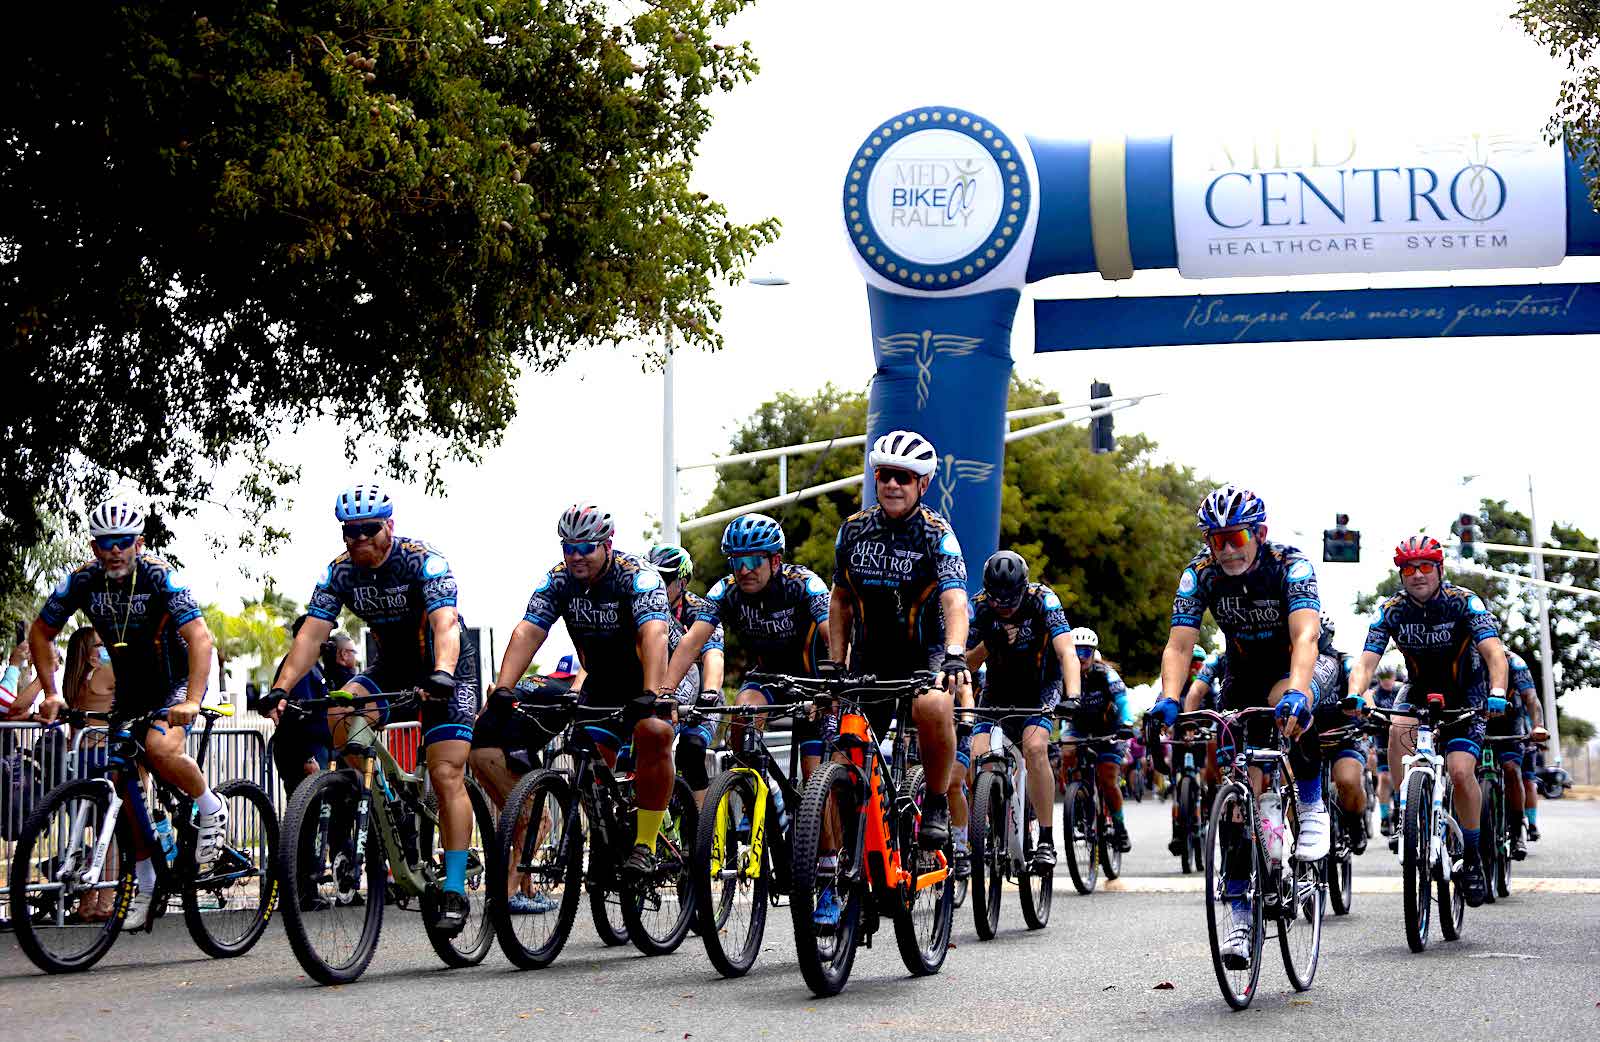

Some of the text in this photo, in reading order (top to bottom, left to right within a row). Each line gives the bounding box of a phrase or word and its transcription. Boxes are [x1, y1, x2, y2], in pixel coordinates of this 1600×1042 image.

[896, 163, 950, 186] MED
[892, 187, 947, 207] BIKE
[1204, 162, 1508, 229] CENTRO
[890, 208, 975, 227] RALLY
[1208, 234, 1508, 257] HEALTHCARE SYSTEM
[853, 540, 886, 556] MED
[850, 552, 913, 574] CENTRO
[1397, 630, 1451, 645] CENTRO
[1399, 623, 1426, 635] MED
